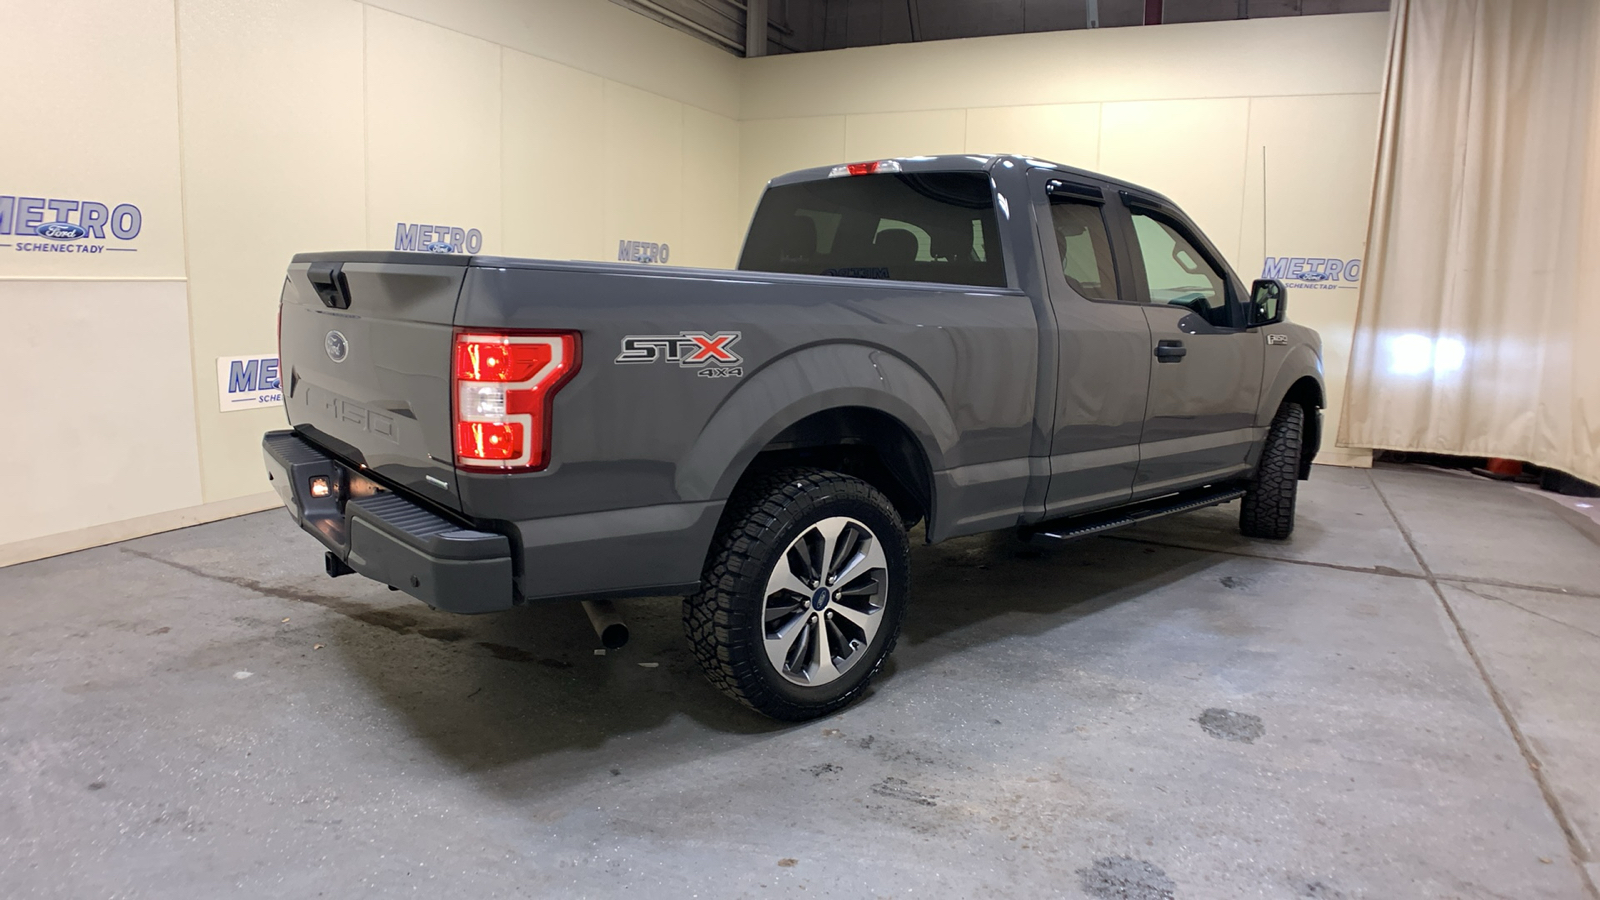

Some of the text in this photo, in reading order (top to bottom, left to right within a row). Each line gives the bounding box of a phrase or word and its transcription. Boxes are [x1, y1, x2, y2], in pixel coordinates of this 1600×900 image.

[45, 224, 77, 238] Ford
[394, 222, 482, 254] METRO
[15, 242, 104, 253] SCHENECTADY
[618, 239, 669, 264] METRO
[1261, 257, 1361, 282] METRO
[1285, 282, 1337, 290] SCHENECTADY
[614, 331, 743, 367] STX
